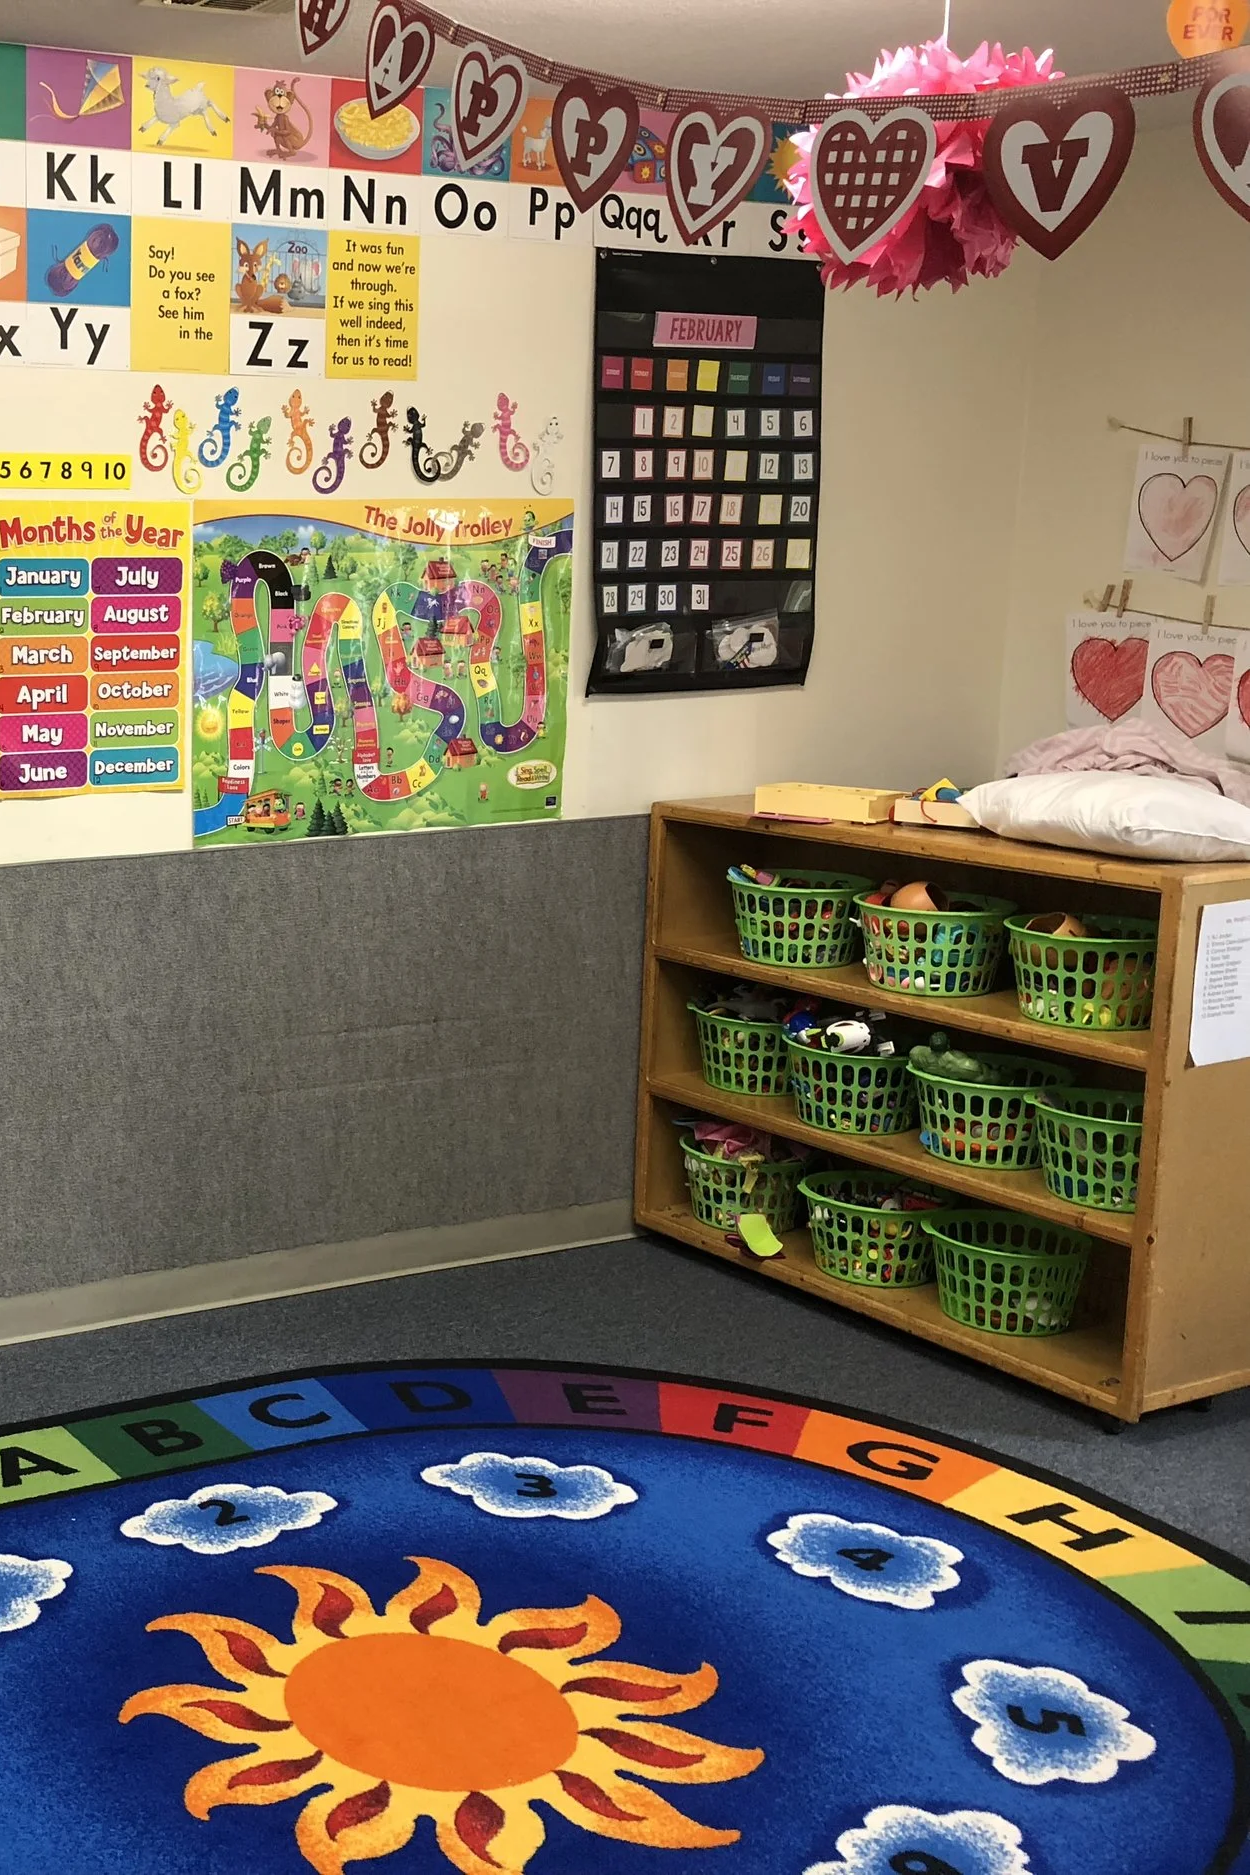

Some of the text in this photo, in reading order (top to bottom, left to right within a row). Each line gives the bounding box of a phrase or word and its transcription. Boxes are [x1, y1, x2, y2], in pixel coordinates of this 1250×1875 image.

[462, 80, 499, 137] P
[570, 119, 608, 177] P
[687, 144, 738, 206] Y
[1021, 137, 1089, 213] V
[149, 245, 175, 261] Say!
[287, 241, 308, 254] Zoo
[345, 240, 404, 255] It was fun
[149, 266, 215, 283] Do you see
[332, 259, 415, 275] and now we're
[162, 287, 201, 301] a fox?
[350, 279, 397, 293] through.
[158, 305, 205, 321] See him
[333, 296, 414, 314] If we sing this
[339, 316, 406, 332] well indeed,
[670, 318, 743, 342] FEBRUARY
[179, 327, 213, 340] in the
[336, 334, 409, 349] then it's time
[332, 353, 412, 367] for us to read!
[0, 461, 11, 478] 5
[20, 461, 32, 478] 6
[40, 462, 51, 478] 7
[61, 462, 72, 479] 8
[81, 462, 92, 479] 9
[104, 462, 125, 480] 10
[608, 456, 774, 474] 7 8 12
[104, 512, 116, 523] of
[638, 501, 808, 516] 15 17 20
[100, 526, 122, 538] the
[126, 514, 184, 548] Year
[365, 506, 513, 542] The Jolly Trolley
[631, 546, 738, 562] 22 25
[5, 567, 81, 587] January
[115, 567, 159, 588] July
[660, 590, 674, 605] 30
[1, 608, 85, 627] February
[104, 605, 169, 623] August
[12, 647, 74, 665] March
[94, 646, 177, 665] September
[17, 685, 68, 709] April
[98, 682, 173, 698] October
[21, 725, 63, 745] May
[95, 722, 174, 738] November
[19, 764, 68, 782] June
[95, 759, 174, 776] December
[711, 1402, 775, 1434] F
[845, 1440, 942, 1482] G
[1006, 1703, 1086, 1738] 5
